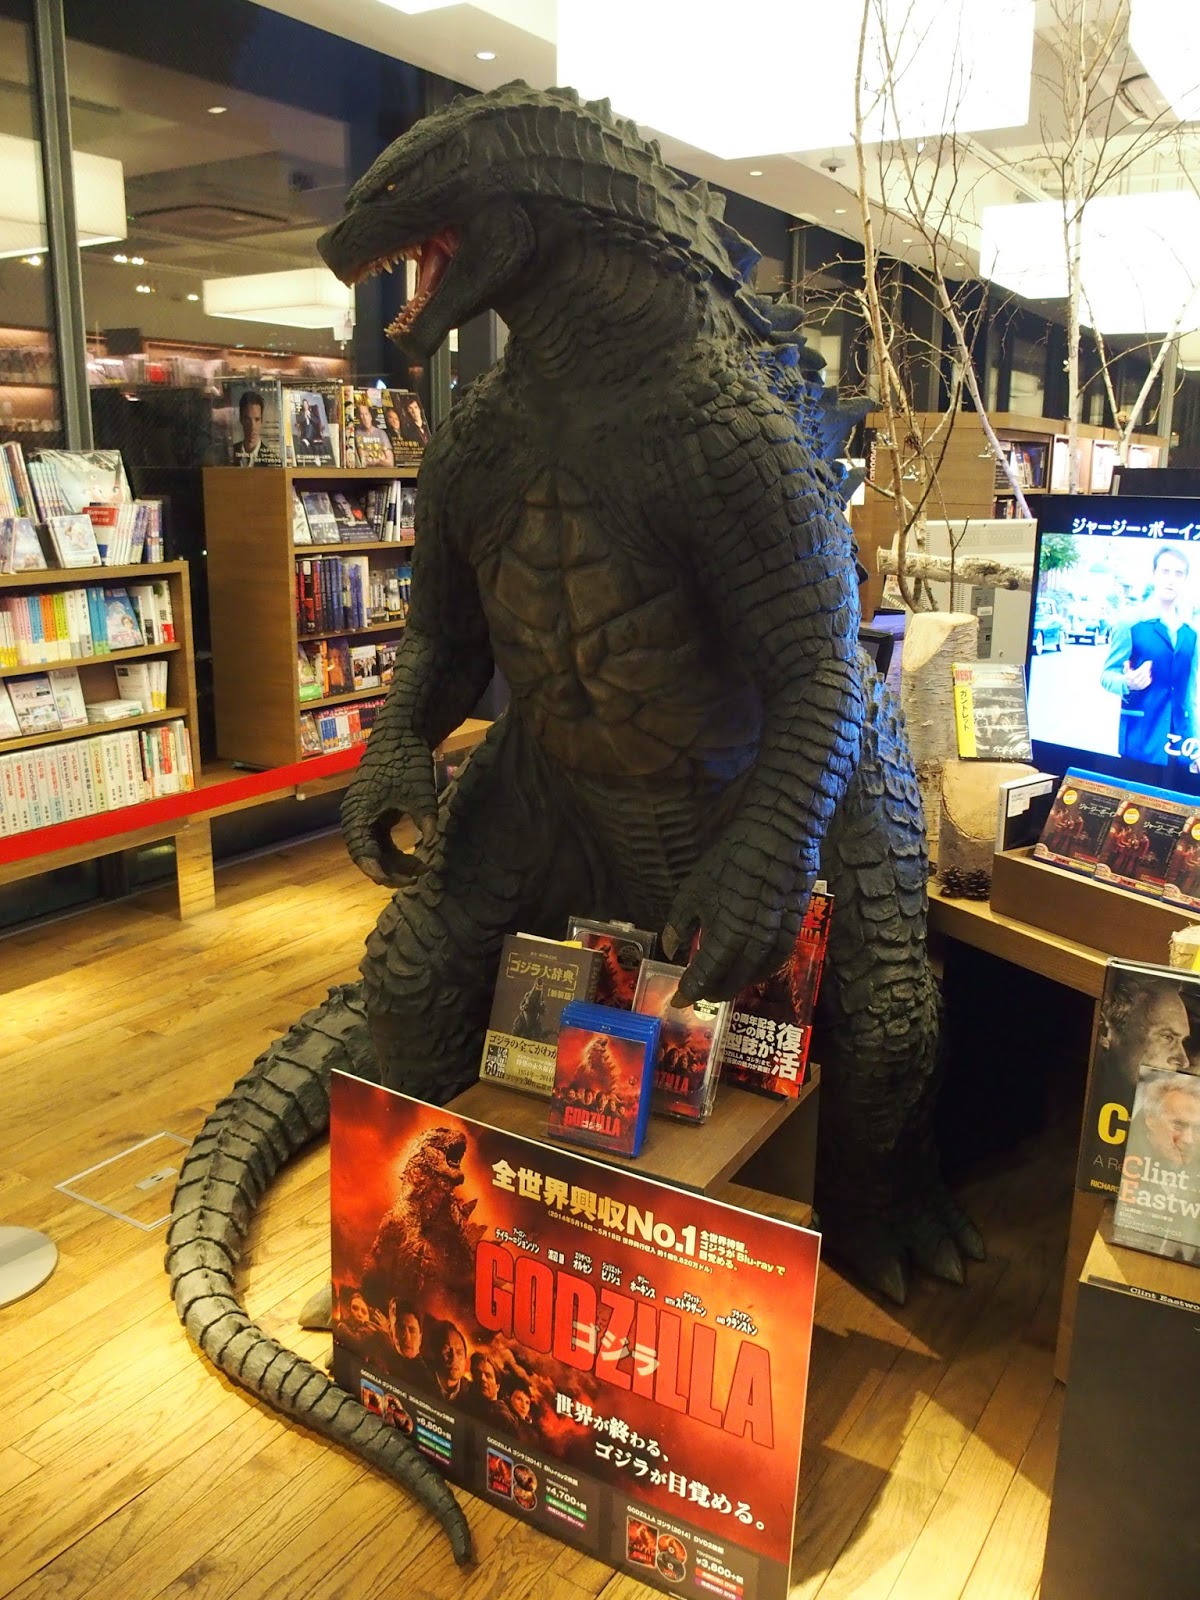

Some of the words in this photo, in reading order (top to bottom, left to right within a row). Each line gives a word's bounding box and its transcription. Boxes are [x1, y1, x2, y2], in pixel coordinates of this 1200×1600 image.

[1164, 733, 1200, 760] この
[509, 959, 575, 984] ゴジラ大辞典
[488, 1034, 558, 1060] ゴジラの全てがわか
[772, 1022, 804, 1081] 復活
[564, 1106, 620, 1138] GODZILLA
[1093, 1154, 1104, 1168] A
[1122, 1155, 1190, 1190] Clint
[491, 1159, 697, 1257] 全世界興収No.1
[1116, 1180, 1200, 1219] Eastw
[572, 1260, 593, 1274] オルセン
[698, 1252, 738, 1271] 目覚める。
[699, 1240, 735, 1259] ゴジラが
[736, 1252, 774, 1273] Blu-ray
[776, 1265, 786, 1276] で
[1130, 1287, 1157, 1300] Clint
[474, 1239, 775, 1450] GODZILLA
[571, 1320, 661, 1377] ゴジラ
[555, 1392, 669, 1463] 世界が終わる、
[594, 1440, 766, 1531] ゴジラが目覚める。
[626, 1505, 656, 1524] GODZILLA
